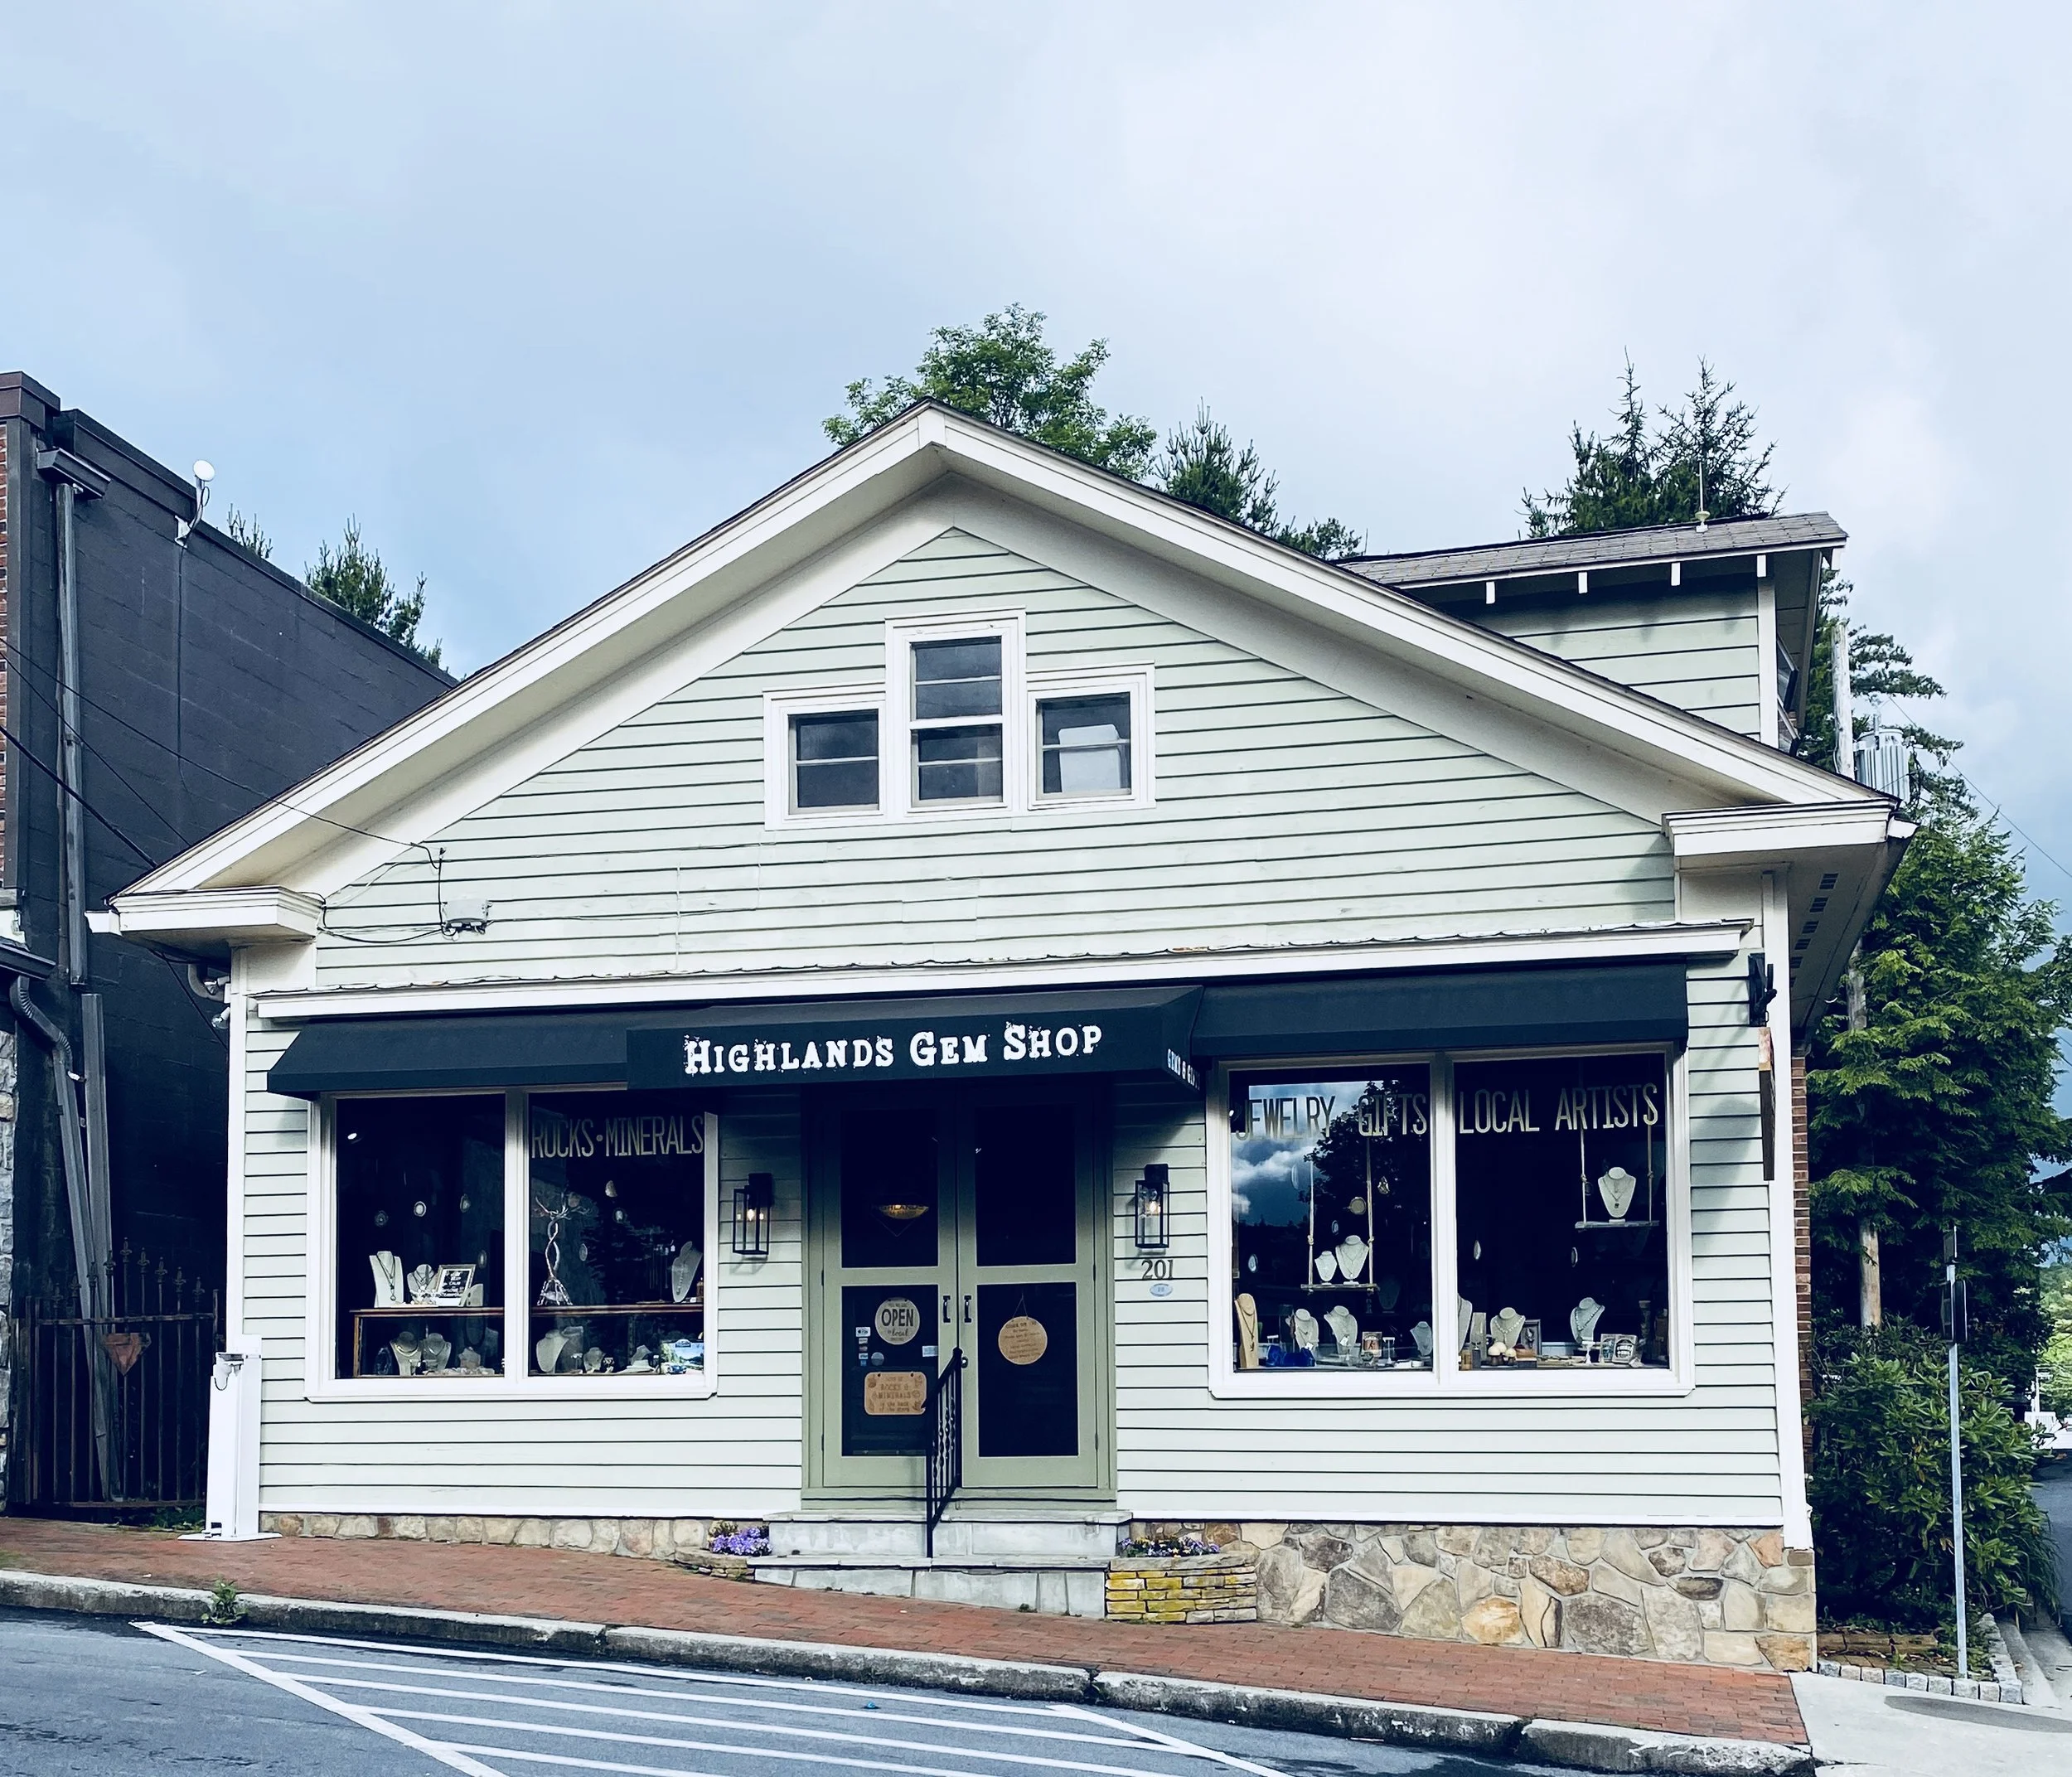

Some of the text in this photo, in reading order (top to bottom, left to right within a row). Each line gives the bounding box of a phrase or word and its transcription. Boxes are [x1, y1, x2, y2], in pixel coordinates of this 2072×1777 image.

[685, 1022, 1102, 1075] HIGHLANDS GEM SHOP
[1236, 1093, 1428, 1140] JEWELRY GIFTS
[1459, 1082, 1658, 1134] LOCAL ARTISTS
[605, 1115, 704, 1157] MINERALS
[1141, 1259, 1174, 1281] 201
[881, 1309, 914, 1327] OPEN
